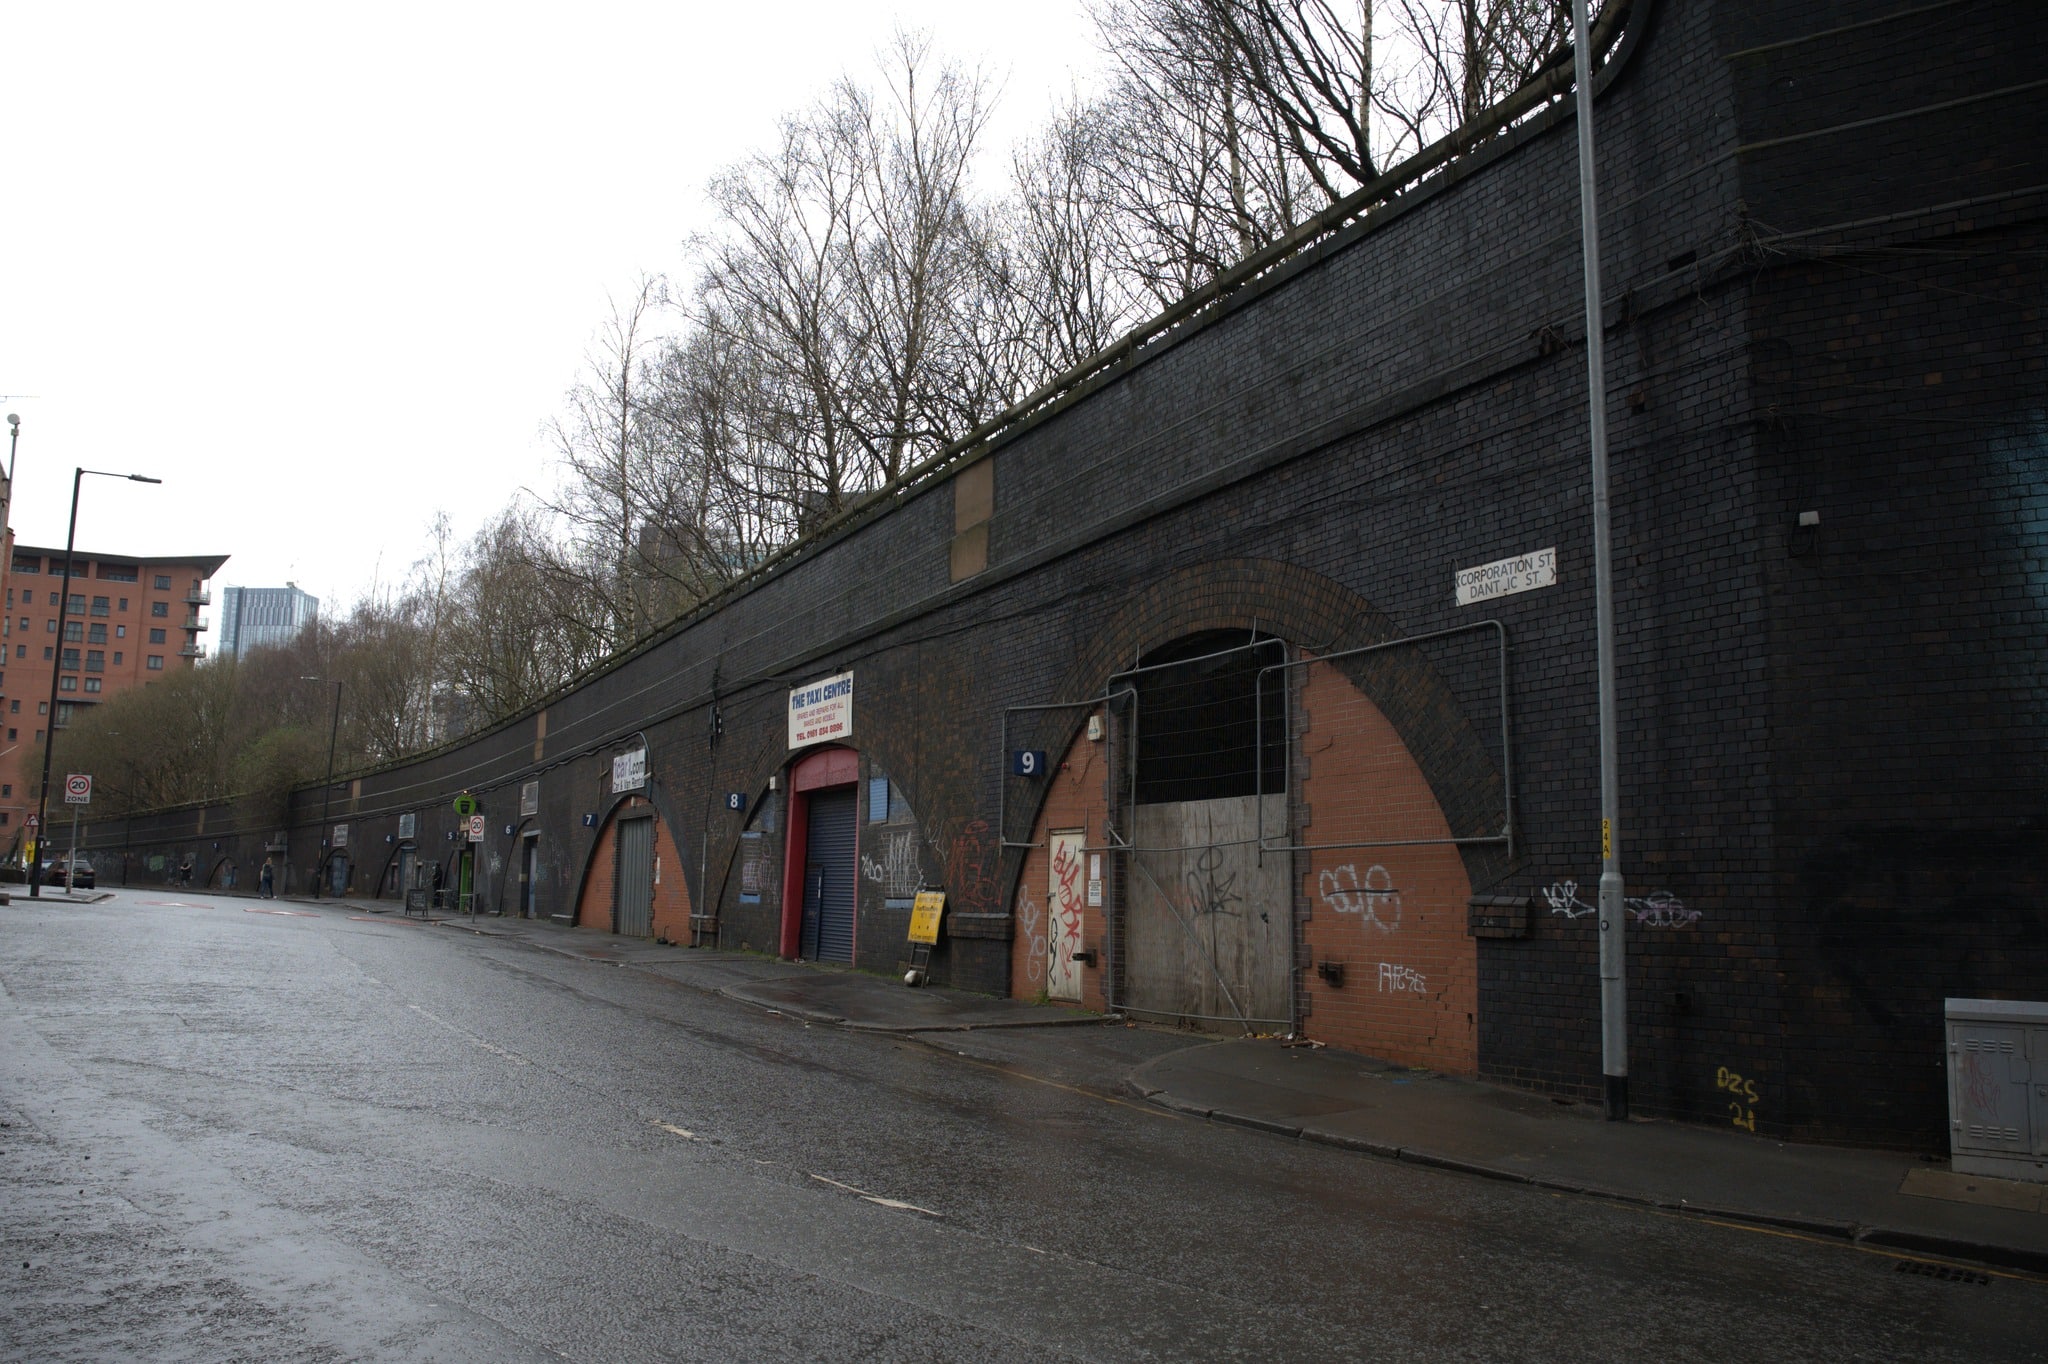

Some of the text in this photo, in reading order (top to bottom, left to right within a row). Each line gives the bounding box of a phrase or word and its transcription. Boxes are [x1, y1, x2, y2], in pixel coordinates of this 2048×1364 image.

[1460, 552, 1554, 586] CORPORATION ST.
[1525, 570, 1542, 586] ST.
[792, 678, 851, 710] THE TAXI CENTRE
[1021, 751, 1035, 774] 9
[72, 781, 86, 790] 20
[730, 793, 739, 809] 8
[472, 821, 482, 829] 20
[585, 814, 593, 826] 7
[447, 831, 453, 840] 5
[505, 824, 511, 835] 6
